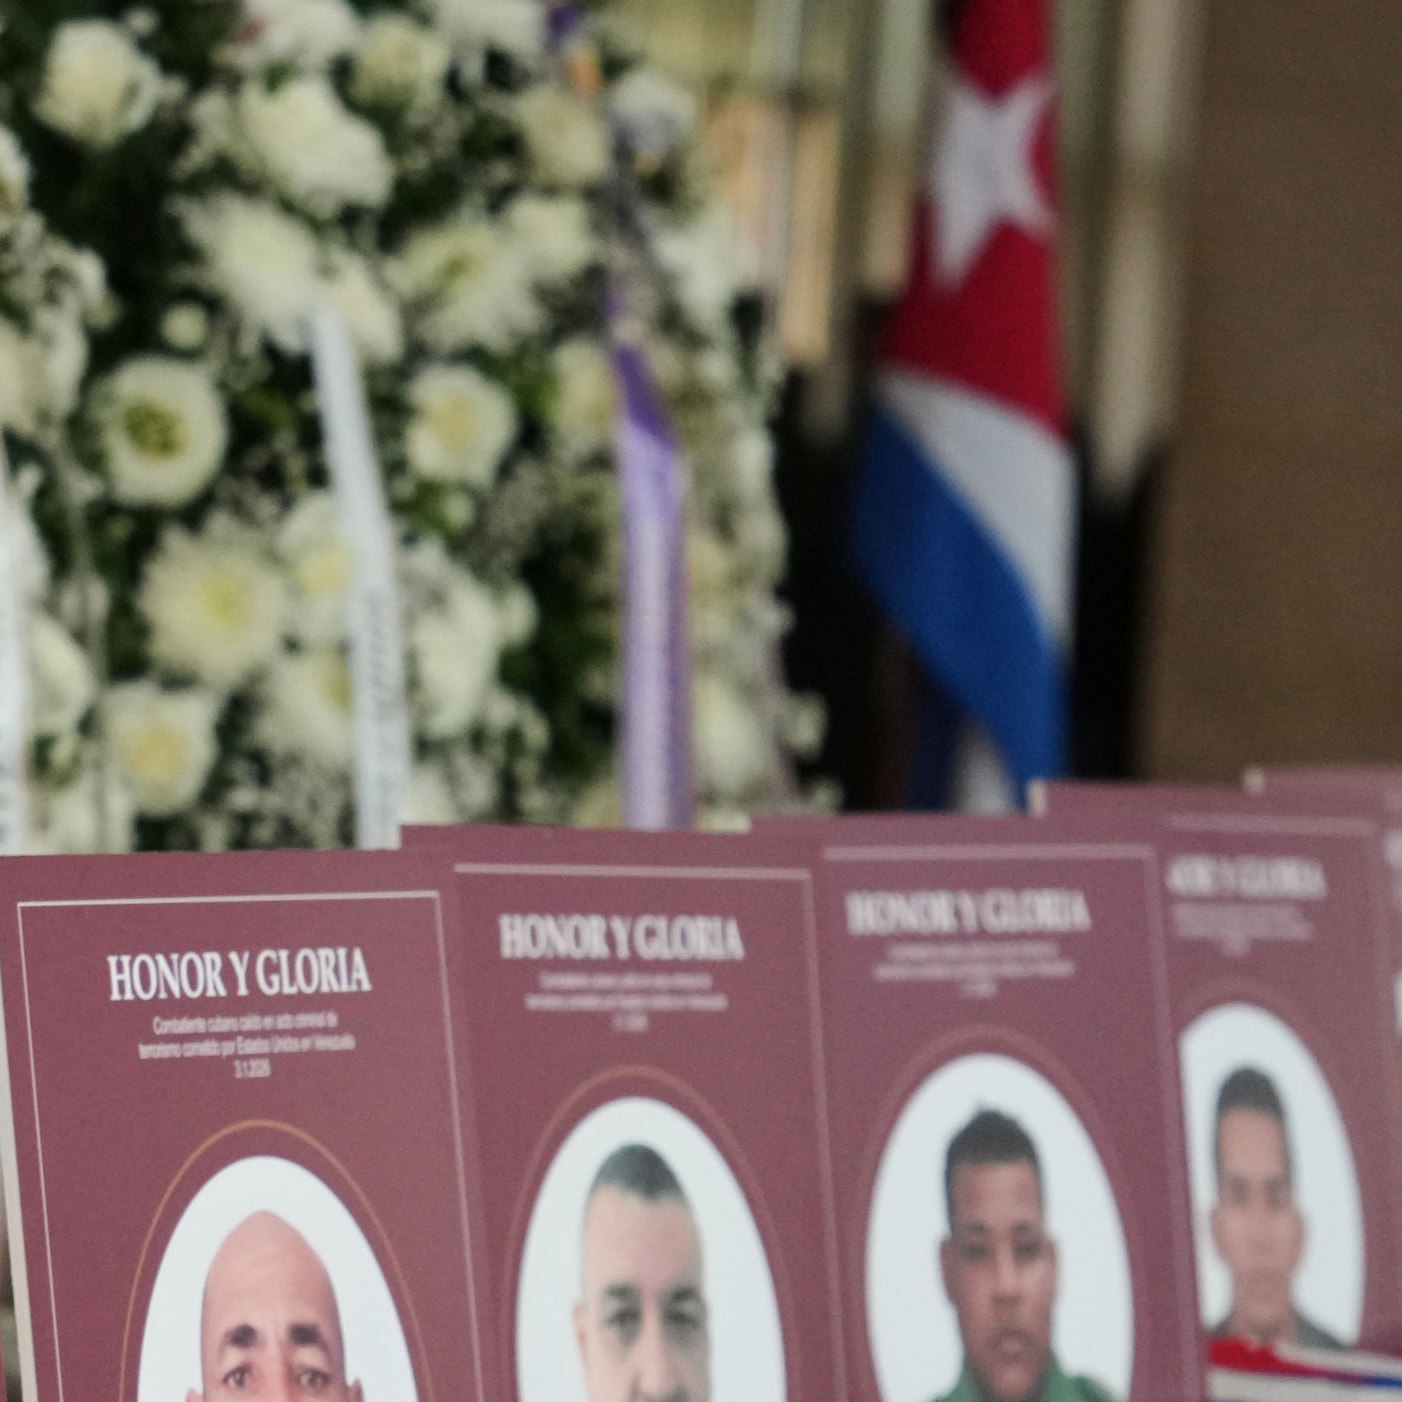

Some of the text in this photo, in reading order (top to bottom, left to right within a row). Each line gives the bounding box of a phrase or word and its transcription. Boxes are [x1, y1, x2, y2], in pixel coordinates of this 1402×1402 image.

[499, 913, 745, 961] HONOR Y GLORIA
[106, 947, 373, 1001] HONOR Y GLORIA
